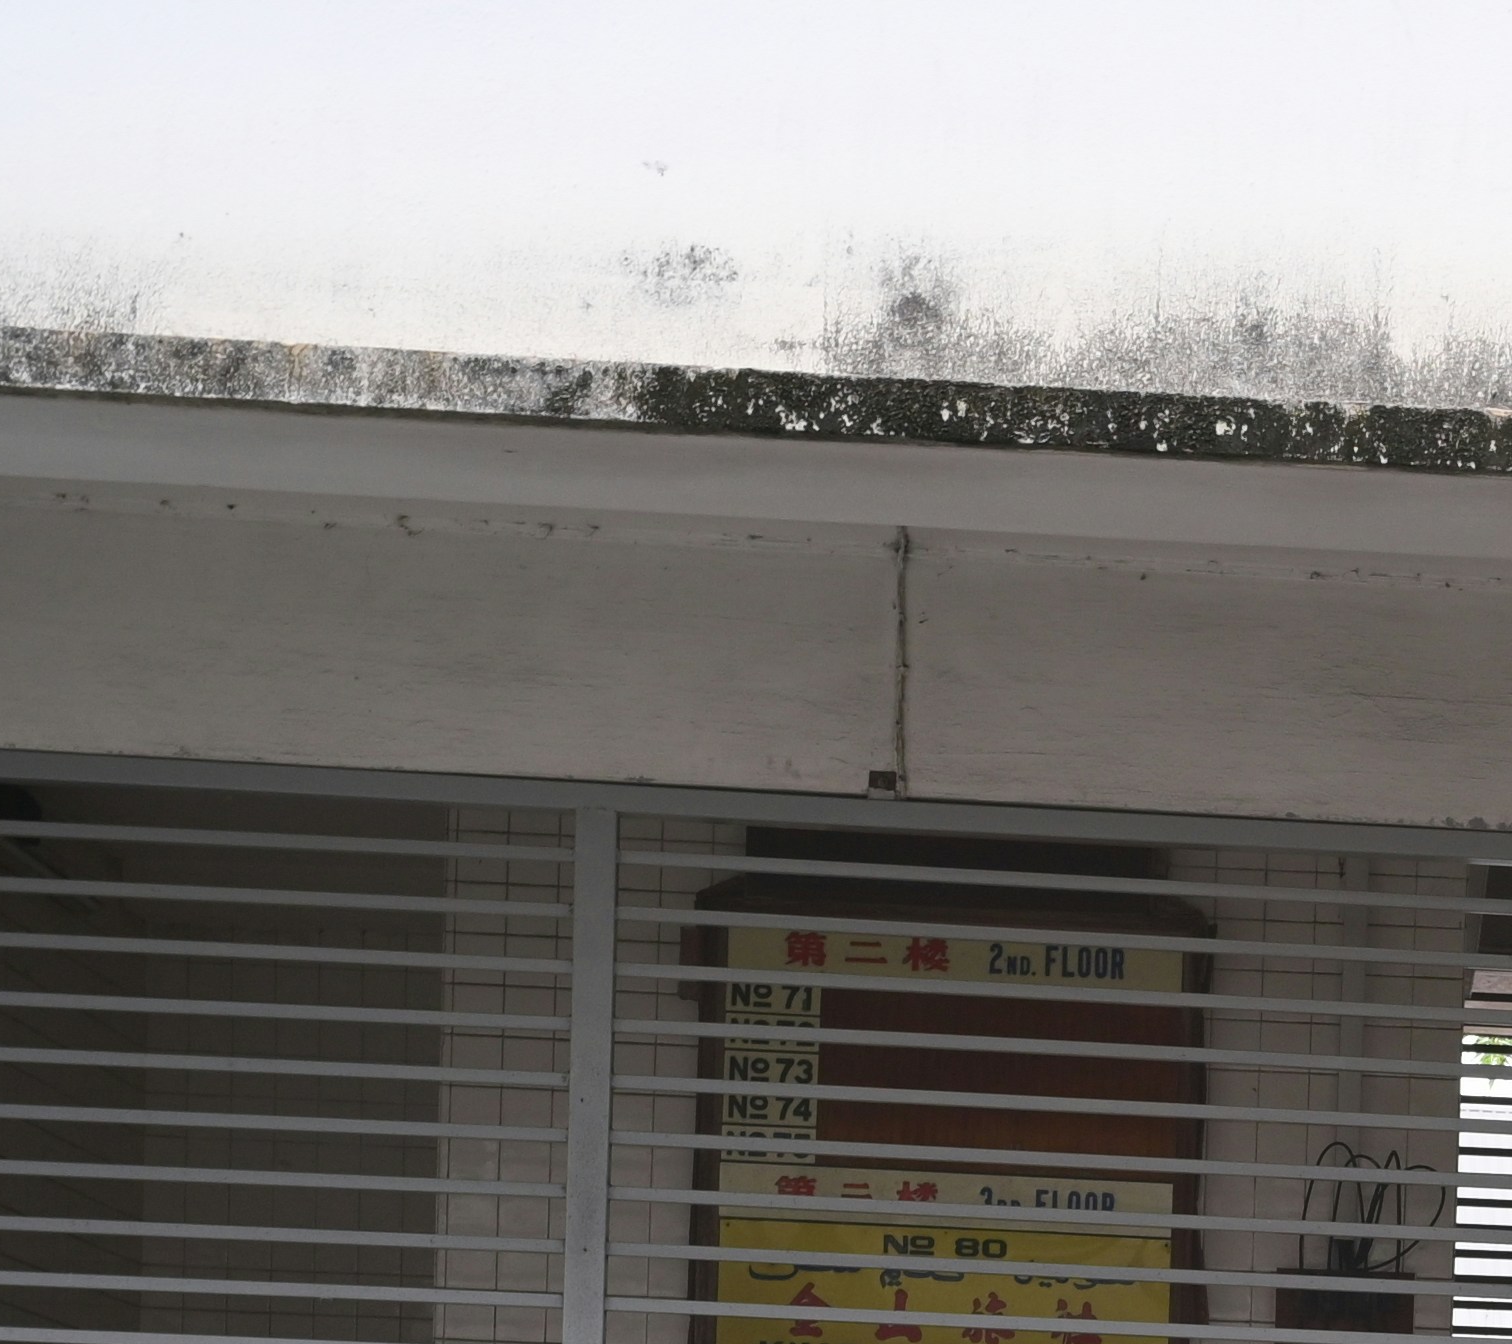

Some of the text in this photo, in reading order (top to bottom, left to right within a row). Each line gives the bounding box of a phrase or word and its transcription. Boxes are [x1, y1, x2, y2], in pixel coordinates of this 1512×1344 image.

[1044, 945, 1126, 981] FLOOR
[781, 984, 813, 1012] 71
[775, 1057, 813, 1085] 73
[779, 1096, 812, 1123] 74
[954, 1237, 1008, 1260] 80
